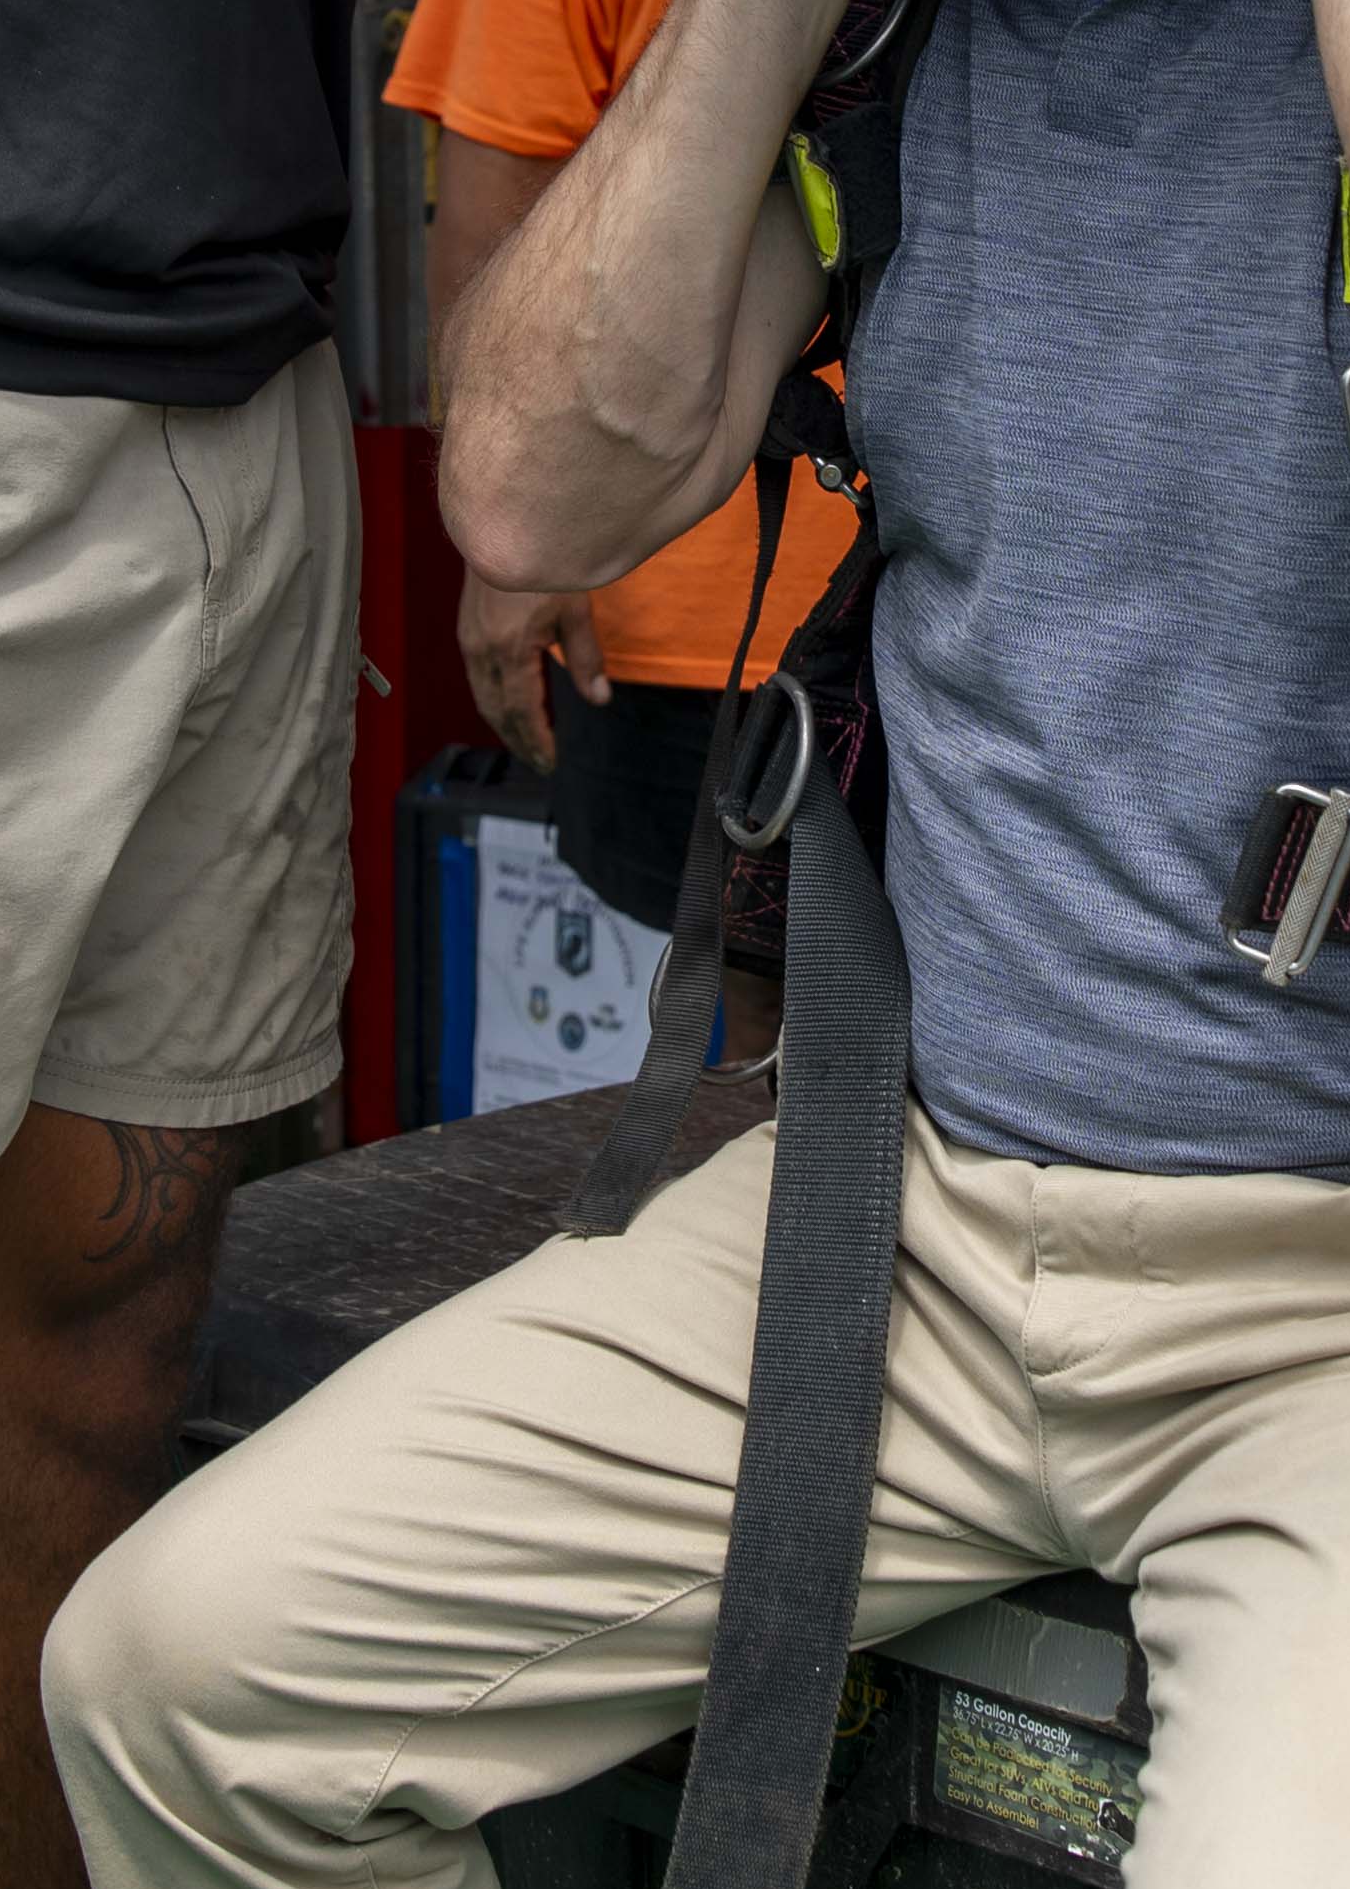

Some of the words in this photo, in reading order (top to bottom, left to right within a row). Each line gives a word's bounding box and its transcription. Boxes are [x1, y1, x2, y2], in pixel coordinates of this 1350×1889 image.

[955, 1690, 970, 1709] 53
[973, 1697, 1016, 1725] Gallon
[1018, 1714, 1072, 1746] Capacity
[1023, 1732, 1033, 1745] W
[1071, 1750, 1079, 1762] H
[951, 1746, 981, 1768] Great
[984, 1758, 999, 1774] for
[1031, 1776, 1057, 1796] ATVs
[1058, 1788, 1080, 1806] and
[952, 1726, 974, 1745] Can
[976, 1735, 990, 1751] be
[993, 1742, 1051, 1773] Padlocked
[1052, 1762, 1068, 1780] for
[1070, 1771, 1113, 1798] Security
[947, 1784, 971, 1804] Easy
[973, 1792, 983, 1808] to
[948, 1765, 996, 1795] Structural
[999, 1785, 1028, 1806] Foam
[1031, 1797, 1098, 1831] Construction
